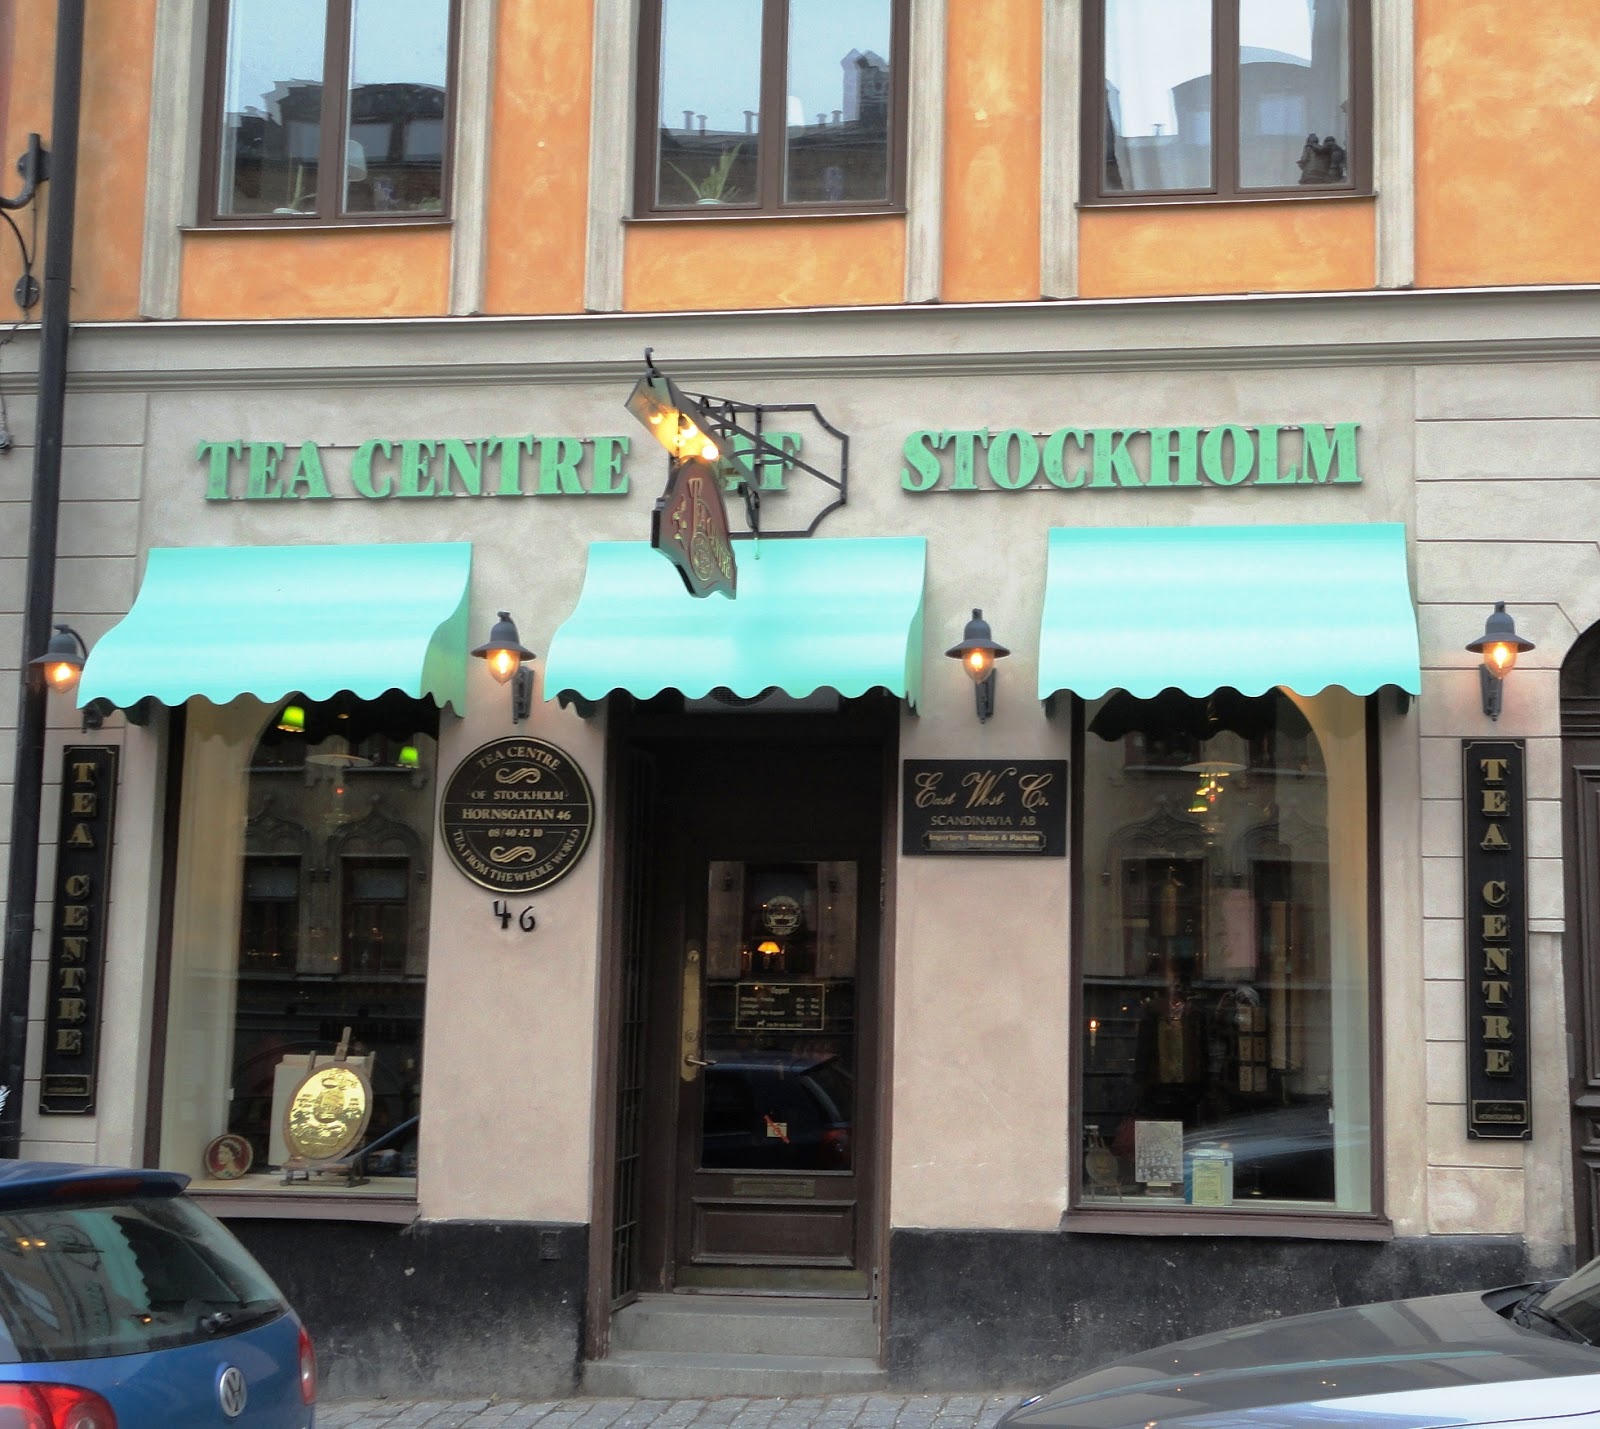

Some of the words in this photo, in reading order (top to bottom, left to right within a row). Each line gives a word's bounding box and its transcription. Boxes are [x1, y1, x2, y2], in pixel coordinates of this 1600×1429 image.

[197, 438, 332, 499] TEA
[351, 434, 630, 498] CENTRE
[900, 422, 1364, 492] STOCKHOLM
[478, 749, 505, 769] TEA
[506, 746, 561, 771] CENTRE
[66, 762, 98, 848] TEA
[471, 790, 487, 800] OF
[493, 790, 564, 801] STOCKHOLM
[914, 771, 957, 809] East
[961, 767, 1018, 809] West
[1479, 758, 1512, 851] TEA
[462, 808, 555, 820] HORNSGATAN
[556, 811, 572, 821] 46
[930, 815, 1013, 827] SCANDINAVIA
[1020, 816, 1037, 826] AB
[453, 828, 467, 852] TEA
[462, 848, 489, 876] FROM
[489, 869, 515, 883] THE
[513, 861, 555, 882] WHOLE
[551, 828, 581, 864] WORLD
[492, 900, 536, 933] 46
[56, 874, 91, 1054] CENTRE
[1481, 880, 1513, 1079] CENTRE
